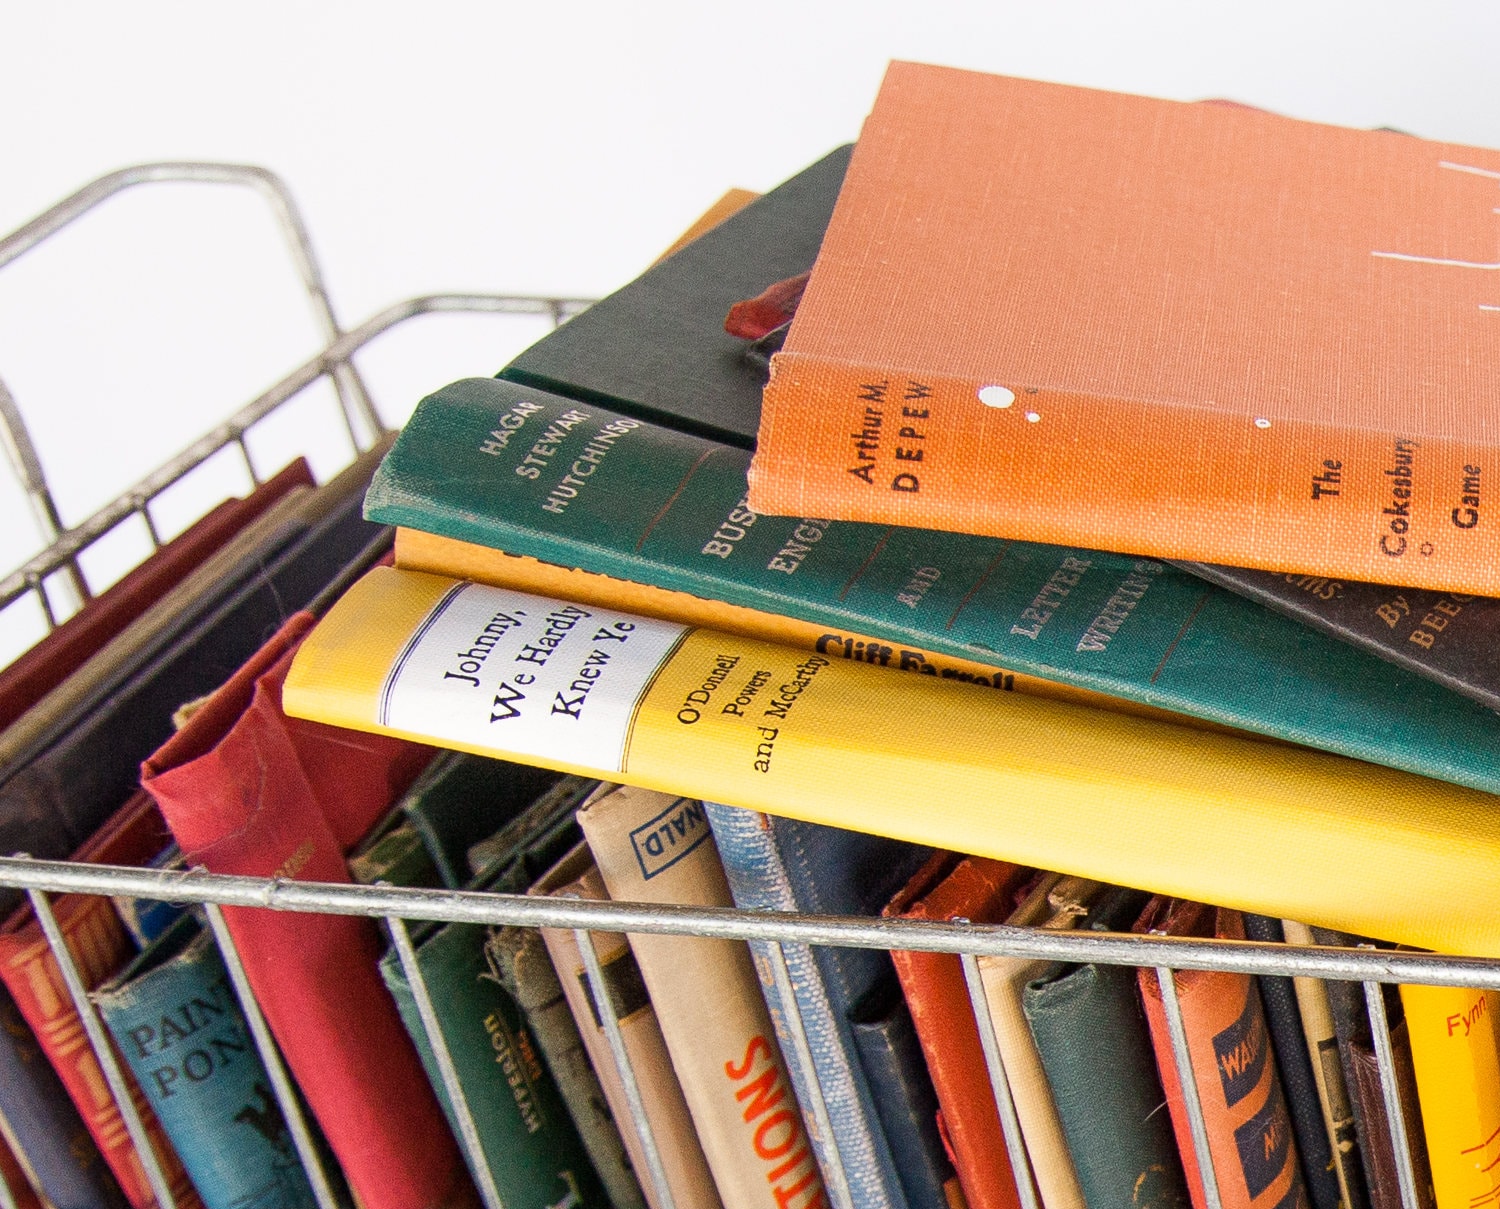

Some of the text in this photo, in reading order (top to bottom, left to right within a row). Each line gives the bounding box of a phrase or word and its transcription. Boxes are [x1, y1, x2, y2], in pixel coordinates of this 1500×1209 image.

[480, 402, 544, 455] HAGAR
[516, 410, 592, 479] STEWART
[849, 409, 888, 485] Arthur
[891, 381, 935, 493] DEPEW
[1311, 458, 1343, 502] The
[1378, 437, 1422, 558] Cokesbury
[1451, 463, 1482, 530] Game
[896, 567, 941, 609] AND
[1011, 557, 1092, 640] LETTER
[1375, 594, 1413, 629] By
[444, 609, 528, 688] Johnny,
[489, 602, 594, 725] We Hardly
[551, 617, 636, 722] Knew Ye
[678, 655, 740, 727] O'Donnell
[722, 668, 772, 719] Powers
[752, 655, 829, 773] and McCarthy
[1447, 995, 1488, 1037] Fynn
